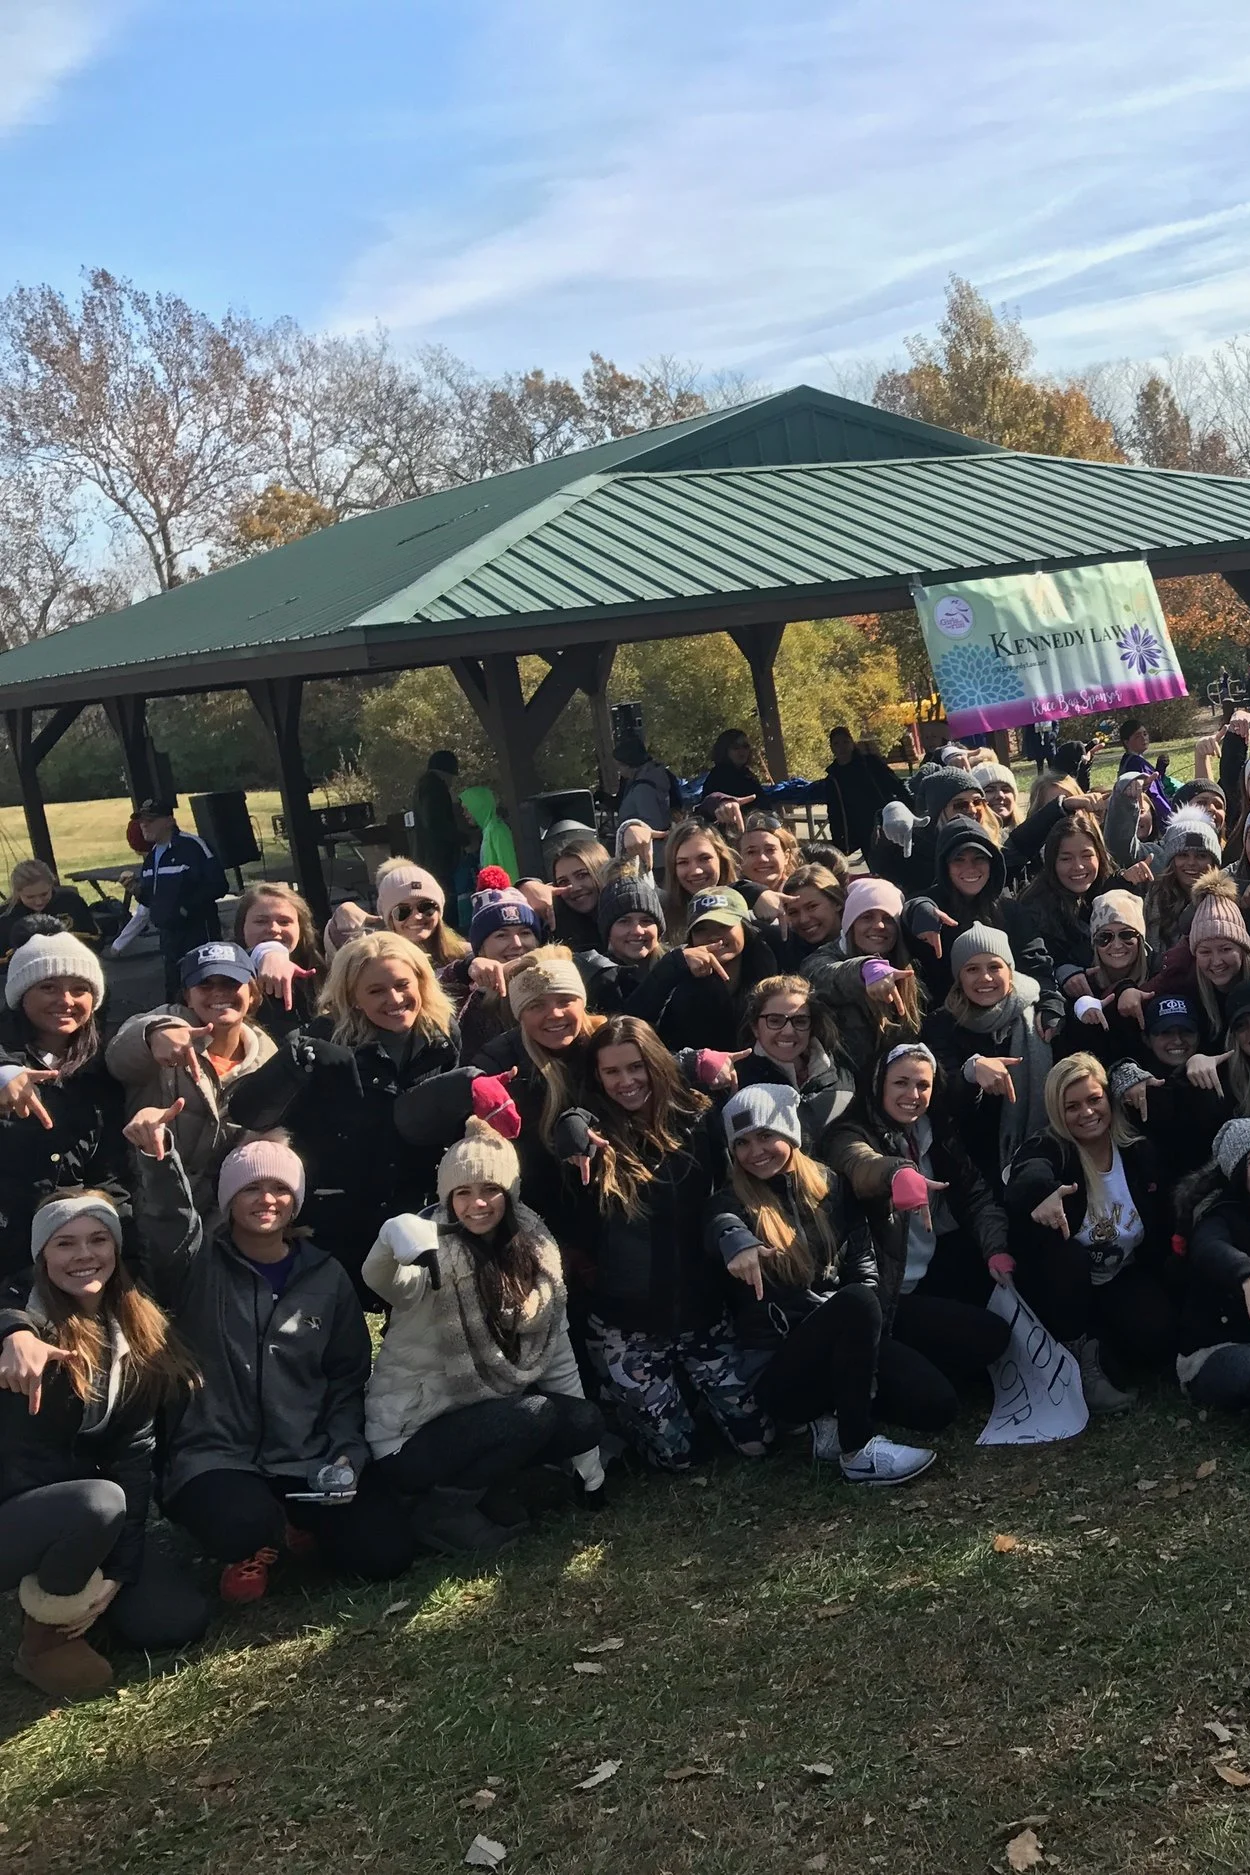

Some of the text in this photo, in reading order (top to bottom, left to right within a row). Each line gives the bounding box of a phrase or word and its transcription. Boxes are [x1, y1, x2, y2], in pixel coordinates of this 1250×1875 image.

[988, 625, 1125, 658] KENNEDY LAW
[1032, 700, 1057, 717] Race
[1080, 689, 1123, 710] Sponsor
